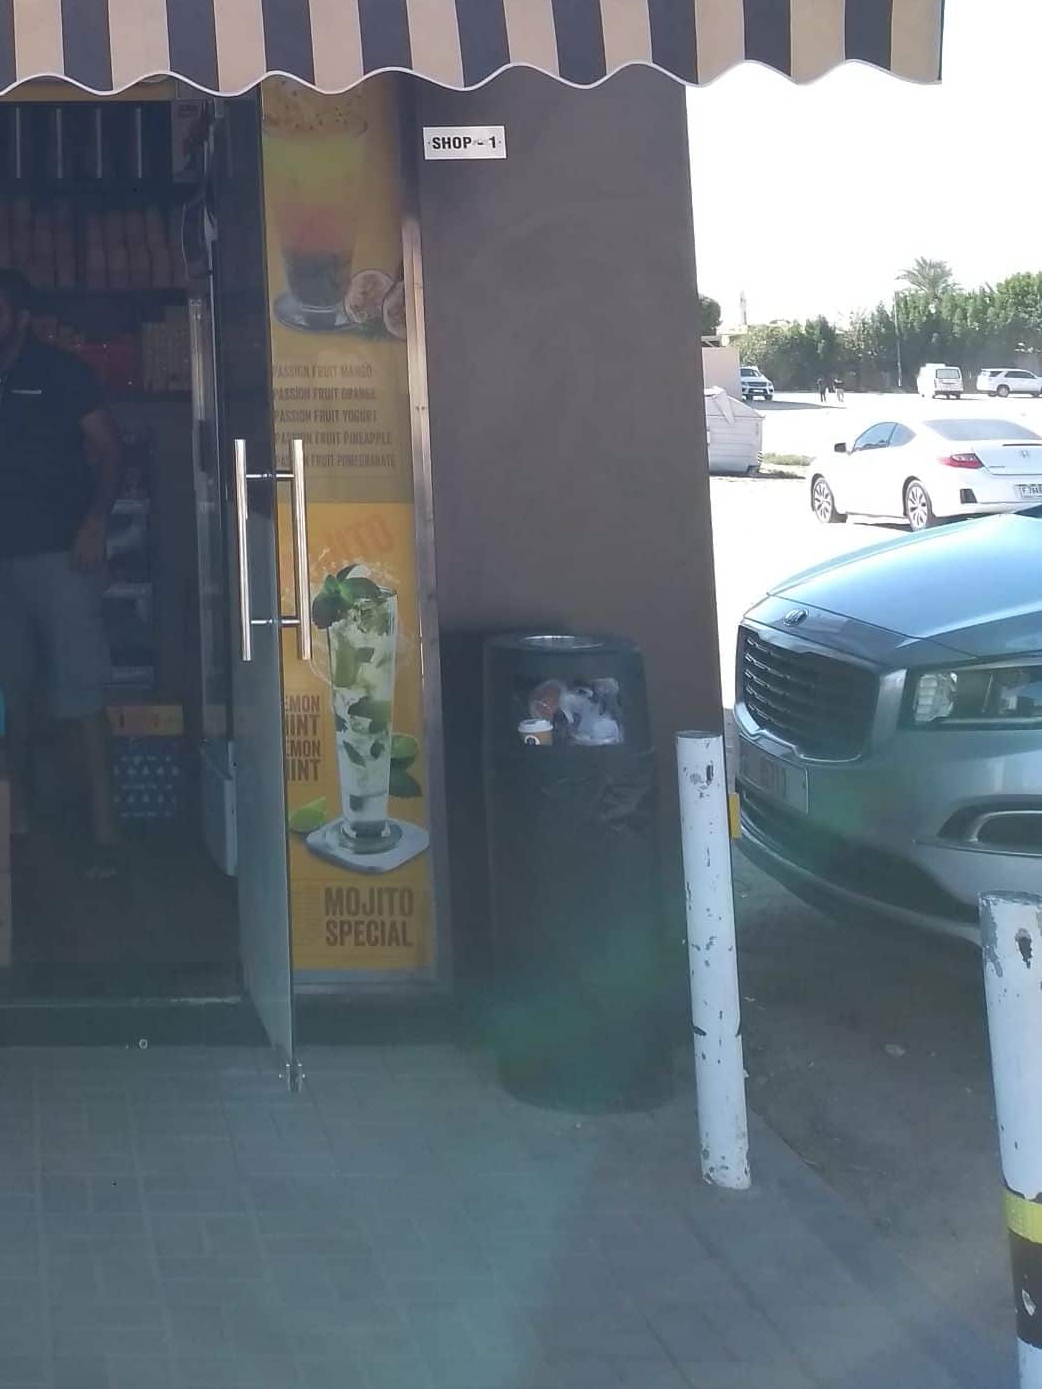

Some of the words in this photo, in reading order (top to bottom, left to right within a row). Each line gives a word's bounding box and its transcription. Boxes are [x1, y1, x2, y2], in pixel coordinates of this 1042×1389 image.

[432, 136, 472, 150] SHOP
[324, 886, 415, 917] MOJITO
[326, 919, 414, 947] SPECIAL
